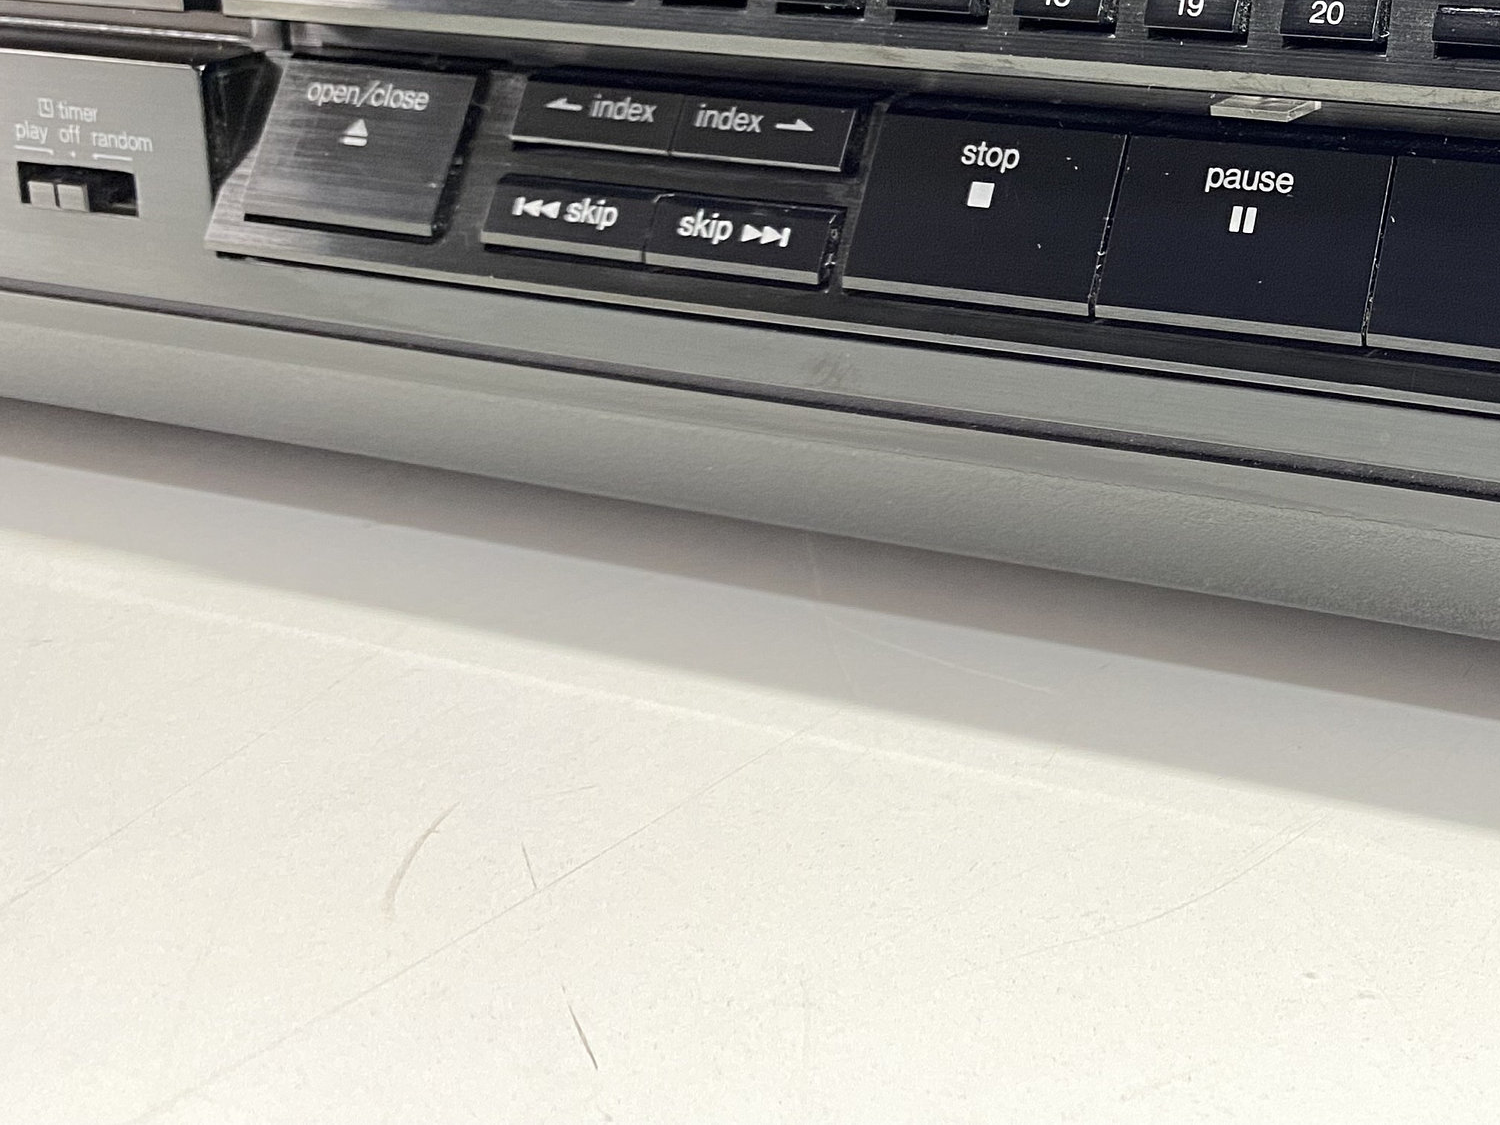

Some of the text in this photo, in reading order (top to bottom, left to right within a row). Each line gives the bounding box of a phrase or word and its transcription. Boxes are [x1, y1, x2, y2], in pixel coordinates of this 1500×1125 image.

[1309, 0, 1344, 26] 20
[307, 80, 430, 111] open/close
[588, 94, 655, 124] index
[57, 99, 99, 123] timer
[694, 103, 762, 134] index
[14, 120, 49, 145] play
[59, 124, 81, 145] off
[90, 131, 153, 153] random
[961, 141, 1020, 173] stop
[1204, 162, 1295, 195] pause
[564, 197, 618, 229] skip
[678, 212, 733, 245] skip
